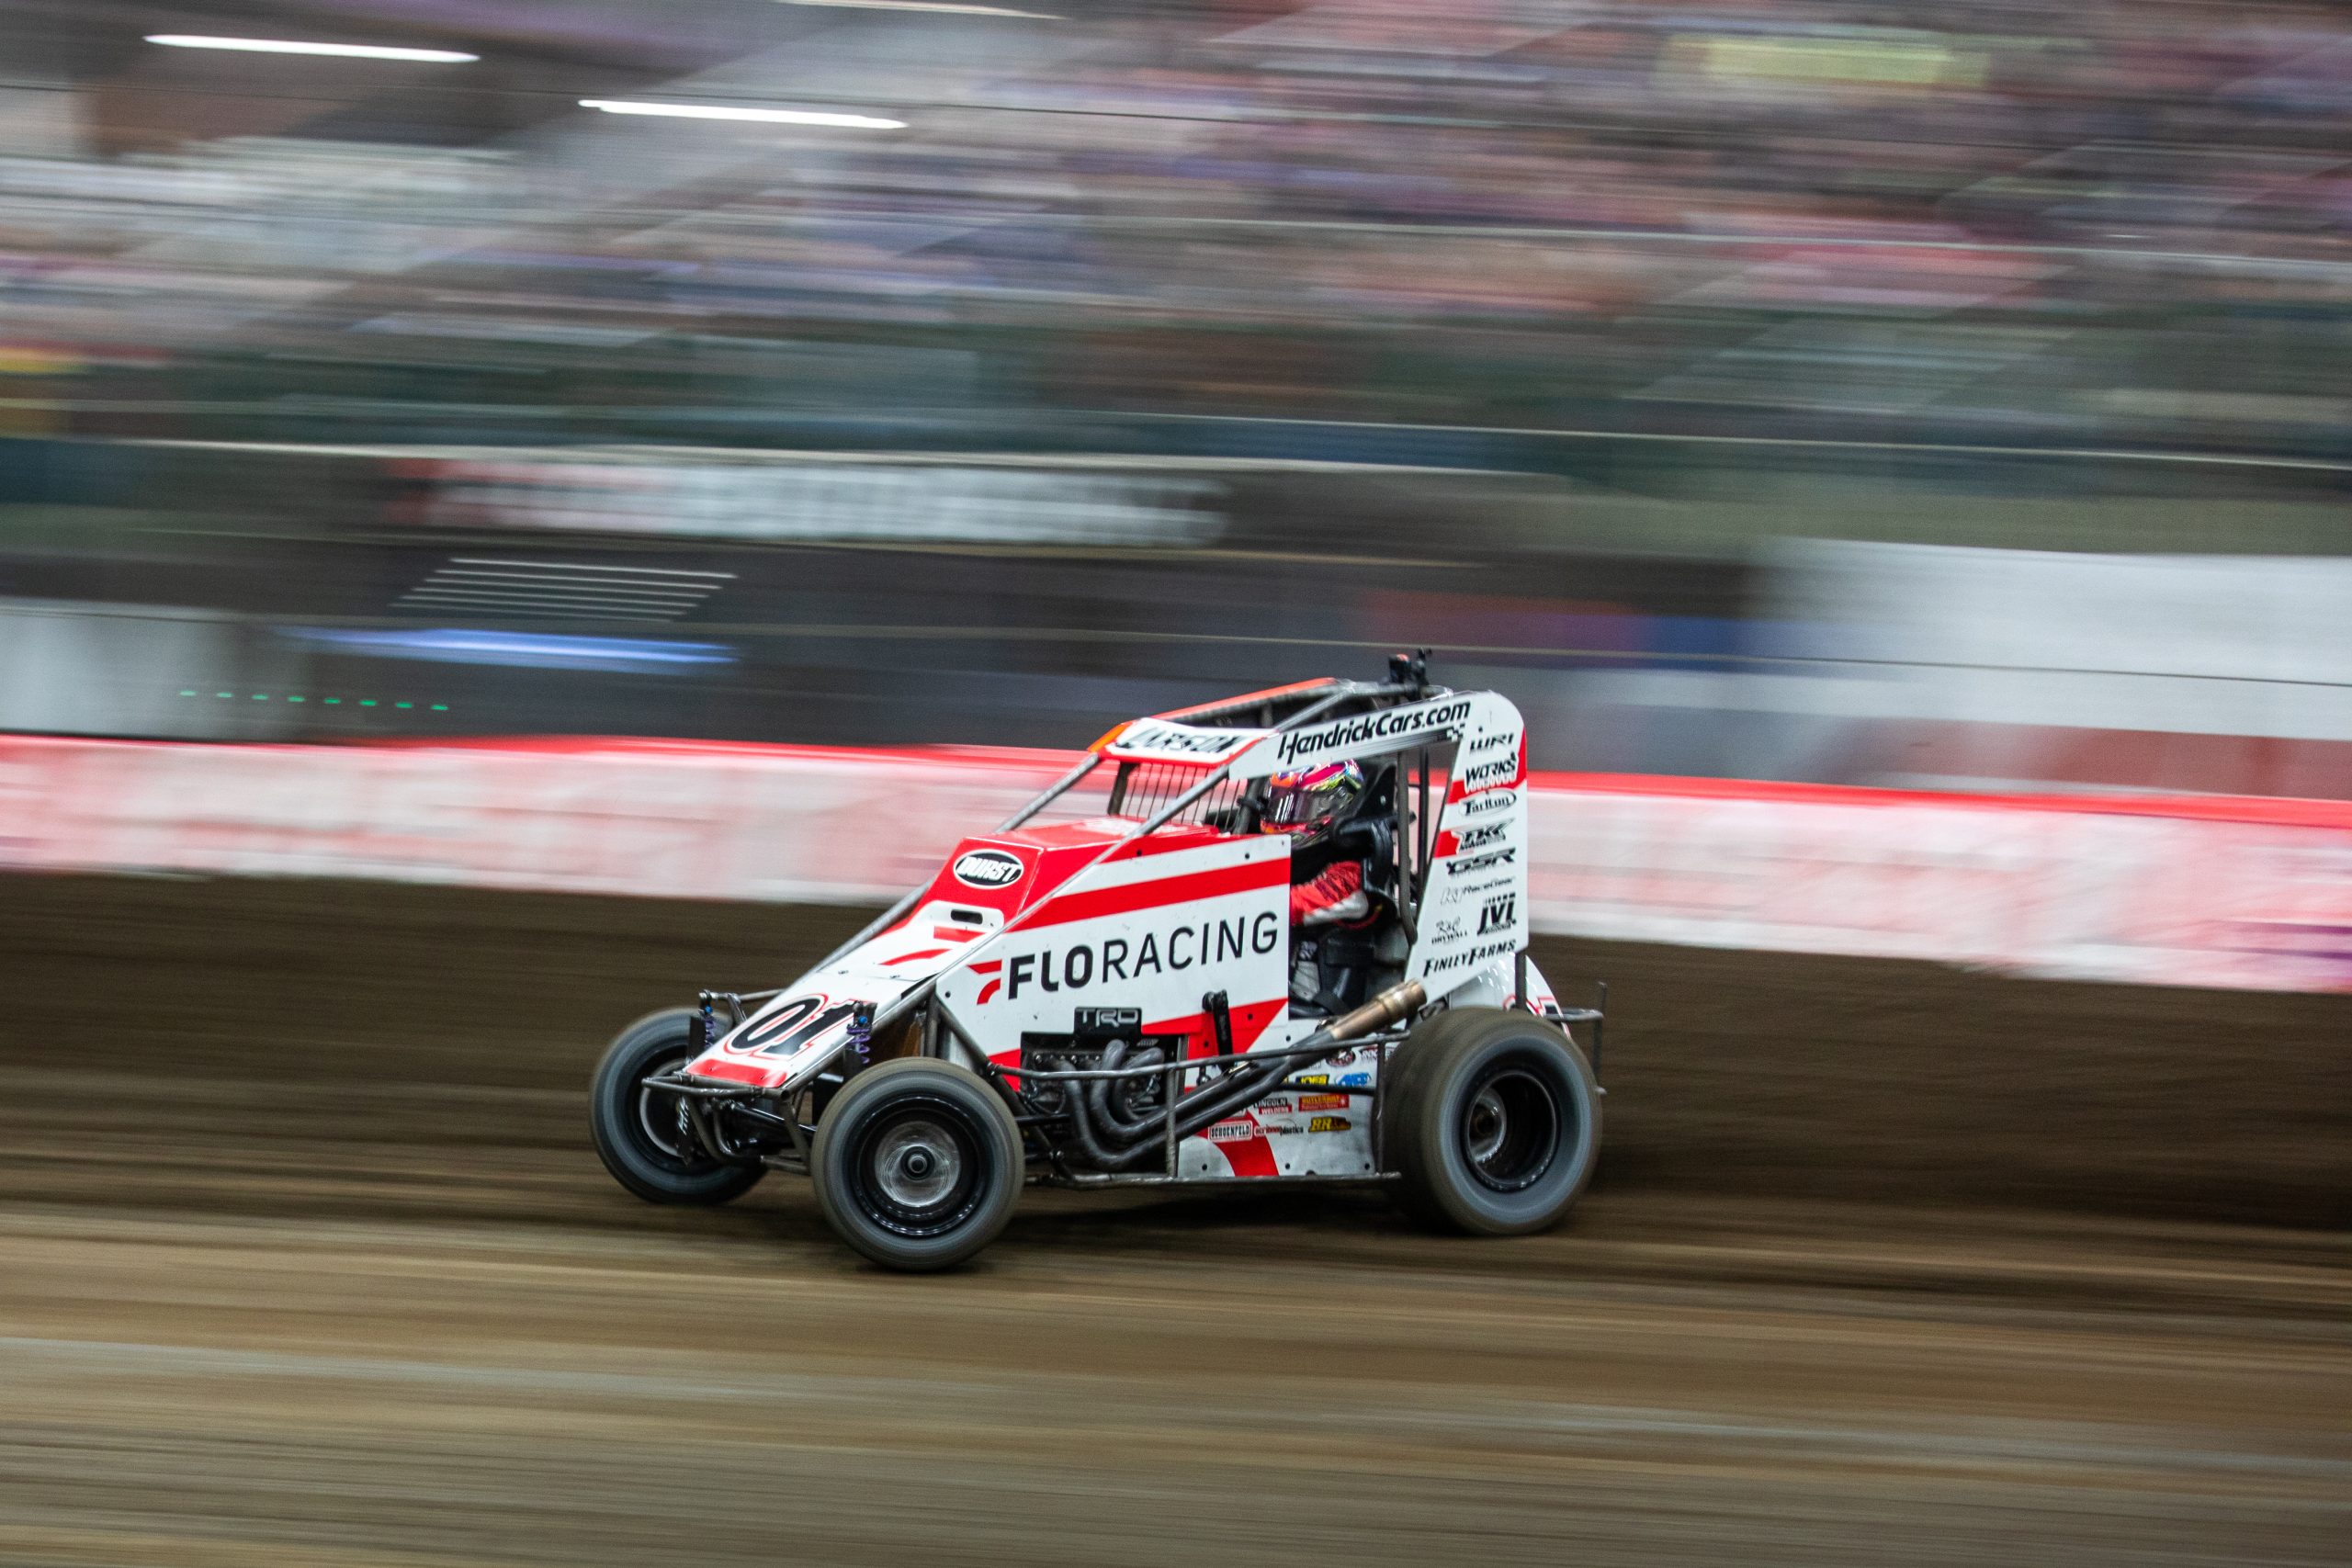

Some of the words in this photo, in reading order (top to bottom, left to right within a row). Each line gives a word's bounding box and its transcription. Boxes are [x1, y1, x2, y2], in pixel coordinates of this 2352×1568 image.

[1277, 701, 1470, 765] HendrickCars.com
[726, 994, 864, 1059] 01
[1081, 1009, 1139, 1028] TRD
[1211, 1124, 1250, 1137] SCHOENFELD
